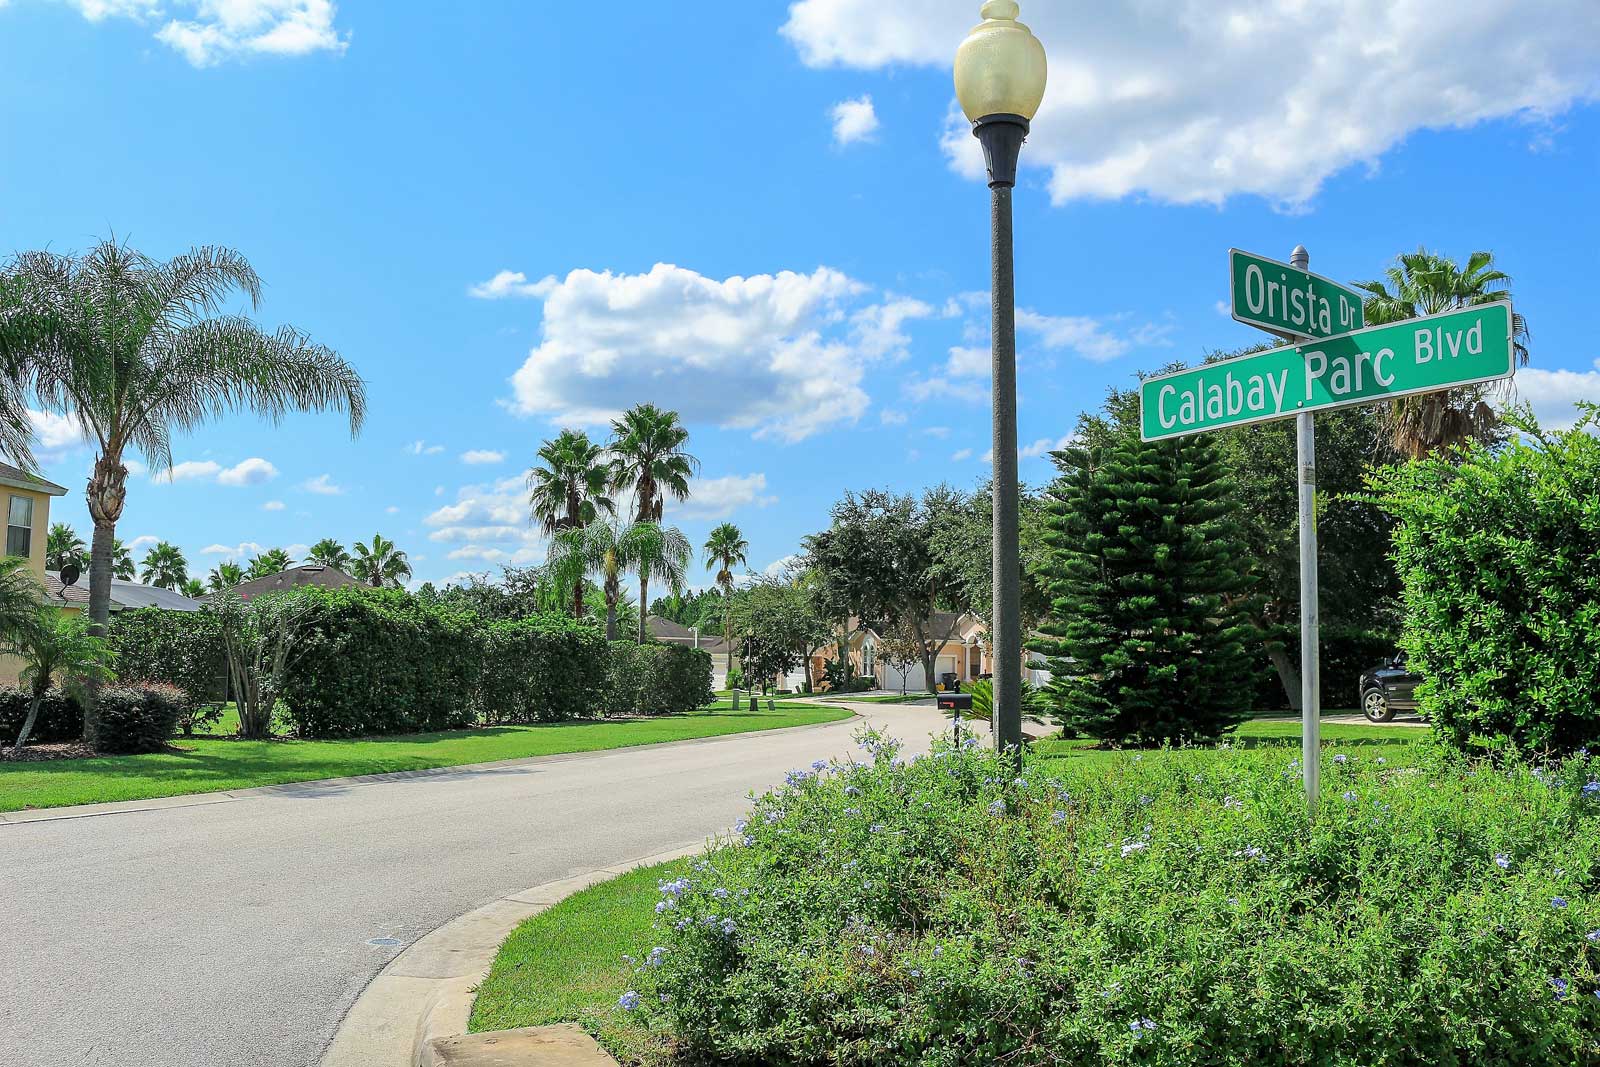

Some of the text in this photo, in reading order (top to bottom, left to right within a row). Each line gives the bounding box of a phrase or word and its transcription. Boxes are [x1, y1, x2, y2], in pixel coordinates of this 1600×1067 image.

[1245, 264, 1356, 334] Orista Dr
[1158, 319, 1483, 429] Calabay Parc Blvd
